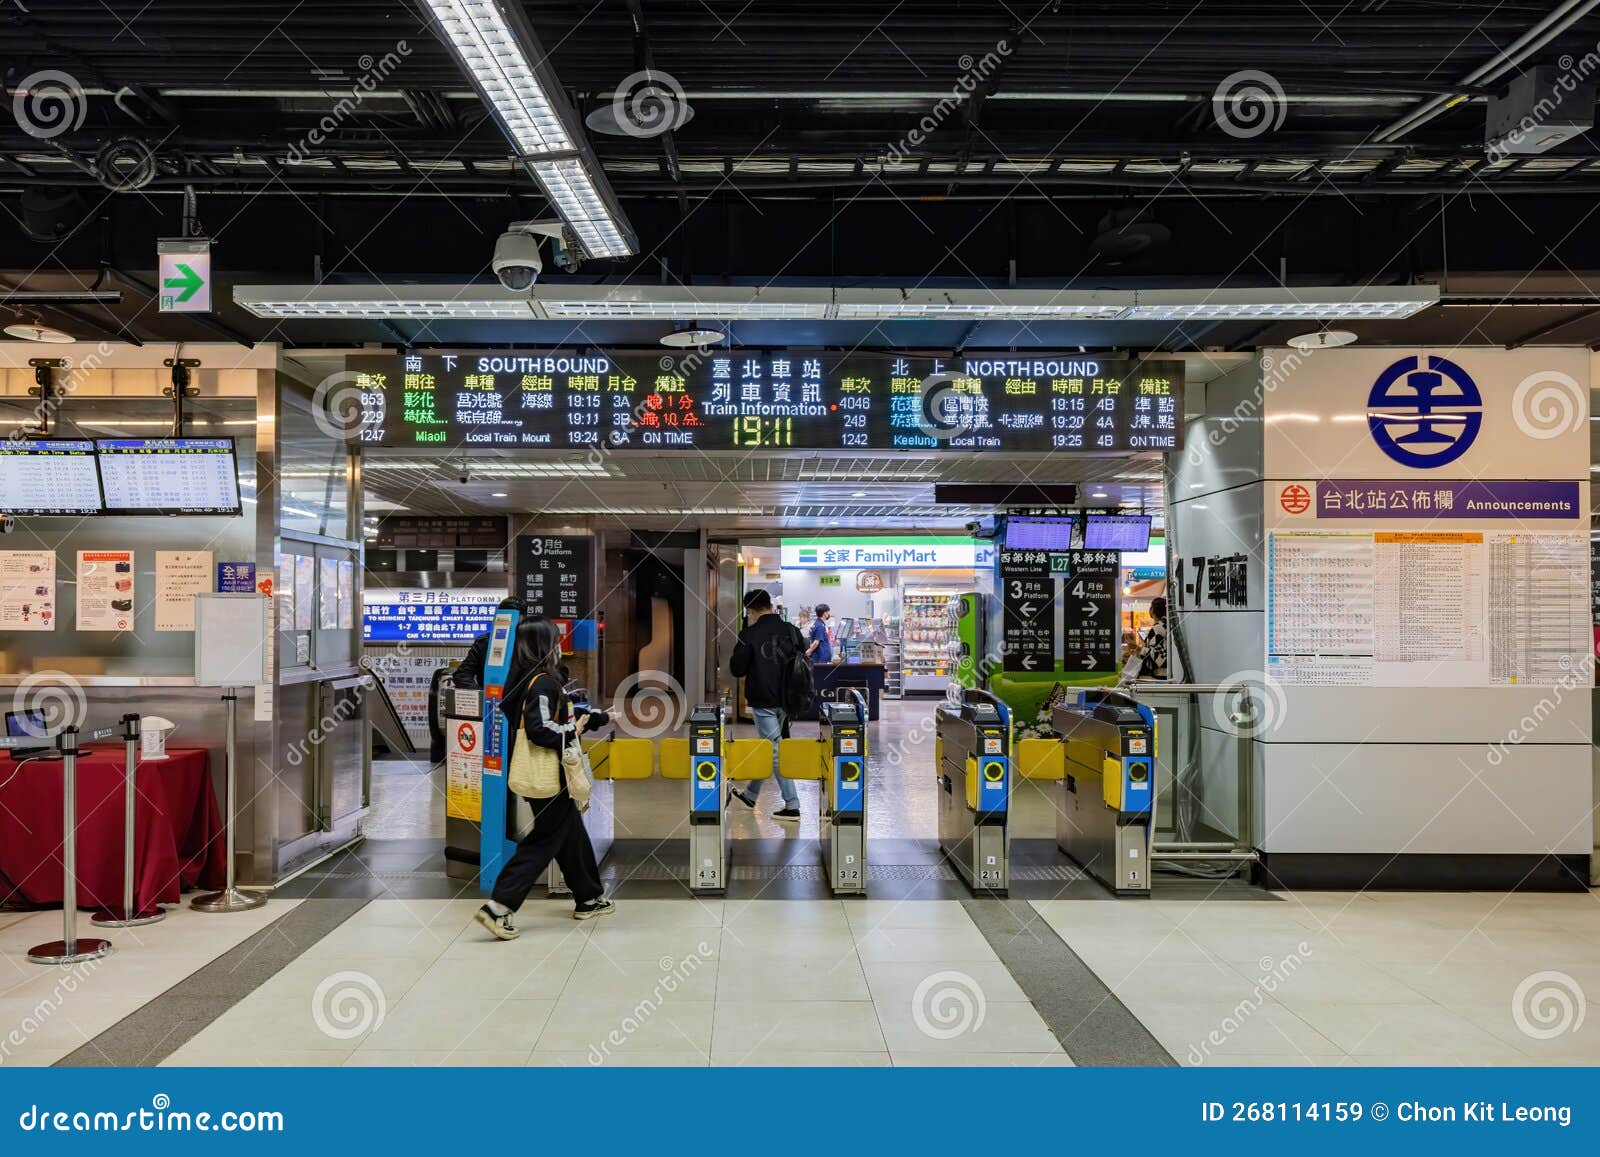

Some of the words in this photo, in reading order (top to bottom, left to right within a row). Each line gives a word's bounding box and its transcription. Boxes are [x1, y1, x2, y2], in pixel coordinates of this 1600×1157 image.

[478, 357, 609, 374] SOUTHBOUND
[713, 359, 821, 379] 臺北車站
[966, 360, 1099, 378] NORTHBOUND
[356, 373, 387, 390] 車次
[405, 374, 436, 391] 開往
[464, 374, 496, 391] 車種
[521, 374, 553, 391] 經由
[568, 375, 600, 392] 時間
[607, 376, 637, 392] 月台
[655, 376, 686, 392] 備註
[840, 376, 871, 394] 車次
[891, 377, 922, 394] 開往
[952, 378, 983, 394] 車種
[1005, 378, 1037, 395] 經由
[1052, 379, 1083, 395] 時間
[1091, 379, 1121, 395] 月台
[1139, 379, 1171, 396] 備註
[712, 381, 822, 403] 列車資訊
[403, 391, 436, 408] 彰化
[521, 393, 553, 409] 海線
[567, 395, 601, 408] 19:15
[612, 395, 631, 408] 3A
[838, 396, 871, 410] 4046
[1050, 398, 1085, 411] 19:15
[1096, 398, 1115, 411] 4B
[702, 401, 738, 416] Train
[740, 401, 828, 416] Information
[1096, 415, 1115, 428] 4A
[360, 430, 385, 442] 1247
[415, 431, 447, 443] Miaoli
[466, 432, 492, 443] Local
[494, 432, 518, 443] Train
[568, 431, 599, 443] 19:24
[612, 432, 631, 444] 3A
[643, 432, 662, 445] ON
[664, 432, 694, 444] TIME
[732, 415, 792, 446] 19:11
[841, 433, 869, 446] 1242
[894, 434, 938, 448] Keelung
[949, 435, 976, 446] Local
[978, 435, 1001, 446] Train
[1051, 434, 1083, 447] 19:25
[1096, 434, 1114, 447] 4B
[1130, 435, 1147, 448] ON
[1148, 435, 1175, 448] TIME
[1322, 489, 1454, 511] 台北站公佈欄
[1475, 499, 1572, 511] Announcements
[531, 538, 543, 556] 3
[544, 540, 563, 549] 月台
[823, 549, 851, 563] 全家
[855, 548, 937, 564] FamilyMart
[1001, 552, 1048, 565] 西部幹線
[1071, 552, 1118, 565] 東部幹線
[540, 560, 550, 569] 往
[558, 561, 566, 569] To
[222, 566, 249, 580] 全票
[1010, 580, 1023, 599] 3
[1025, 583, 1041, 591] 月台
[1072, 580, 1086, 599] 4
[1087, 583, 1104, 591] 月台
[399, 591, 450, 604] 第三月台
[699, 870, 705, 879] 4
[711, 870, 717, 879] 3
[840, 870, 846, 879] 3
[852, 870, 858, 879] 2
[983, 871, 989, 879] 2
